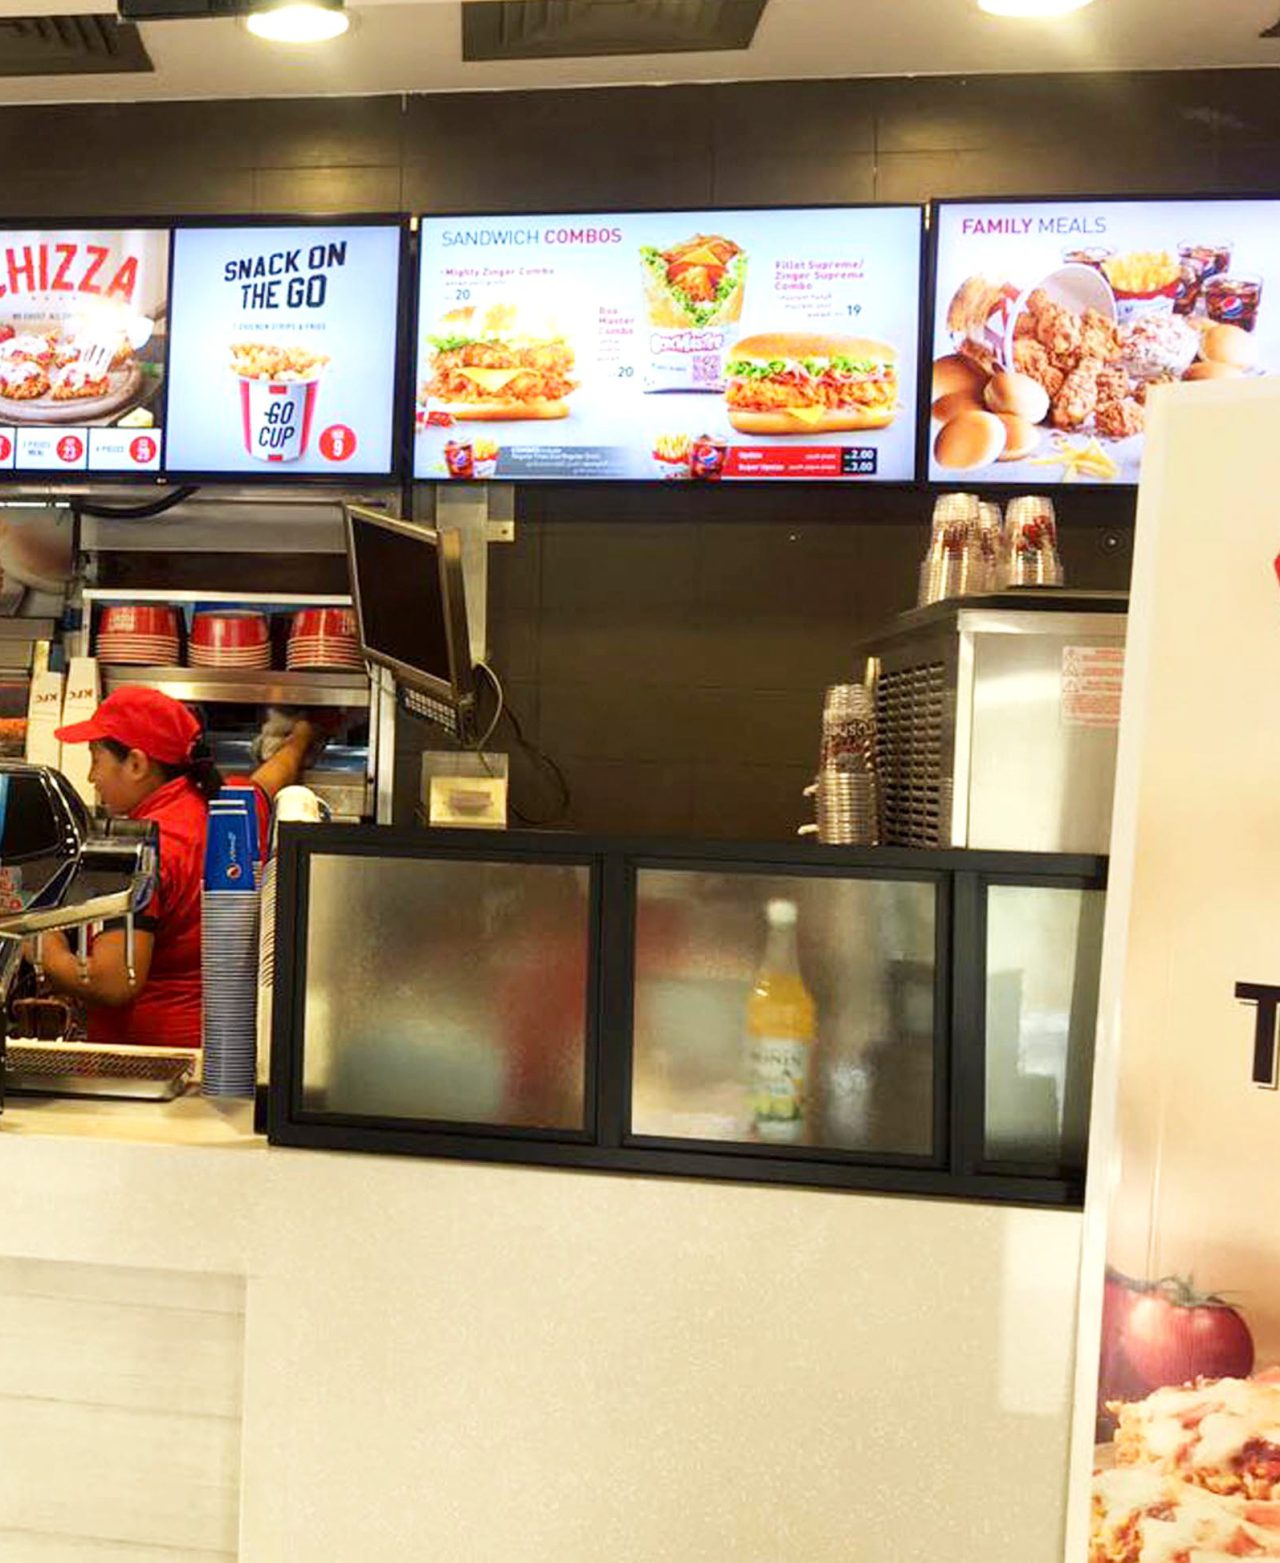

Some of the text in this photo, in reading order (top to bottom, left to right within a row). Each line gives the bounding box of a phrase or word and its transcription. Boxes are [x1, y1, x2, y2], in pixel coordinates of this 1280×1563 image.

[962, 216, 1107, 234] FAMILY MEALS
[441, 228, 622, 247] SANDWICH COMBOS
[224, 241, 347, 282] SNACK ON
[445, 268, 480, 278] Mighty
[482, 268, 515, 278] Zinger
[775, 271, 864, 281] Zinger Supreme
[241, 274, 327, 309] THE GO
[774, 282, 813, 291] Combo
[455, 289, 471, 300] 20
[847, 304, 862, 316] 19
[618, 366, 634, 377] 20
[263, 401, 295, 425] GO
[258, 426, 295, 448] CUP
[333, 439, 344, 457] 9
[851, 450, 874, 459] 2.00
